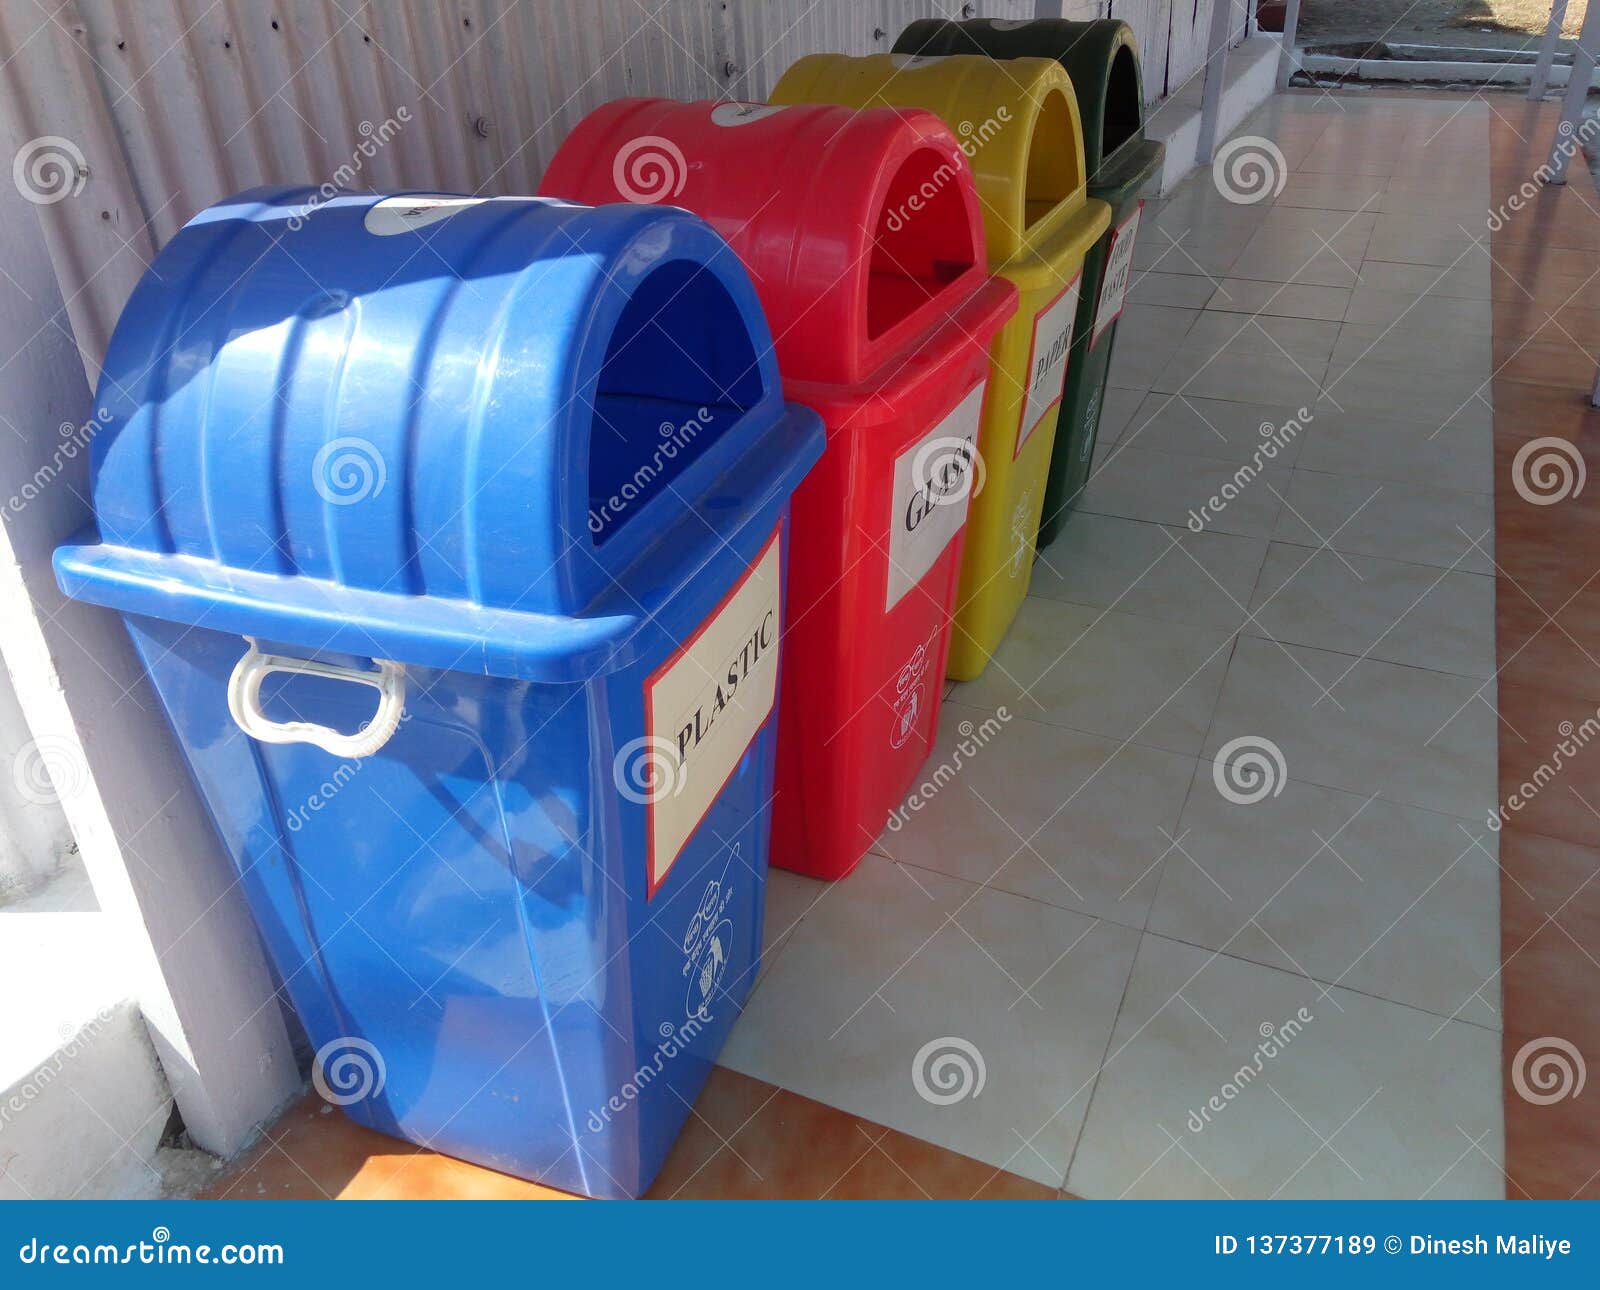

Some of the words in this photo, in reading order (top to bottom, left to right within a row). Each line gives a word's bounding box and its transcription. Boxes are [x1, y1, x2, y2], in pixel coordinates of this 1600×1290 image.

[1034, 323, 1071, 391] PAPER
[905, 436, 972, 531] GLASS
[677, 608, 774, 769] PLASTIC
